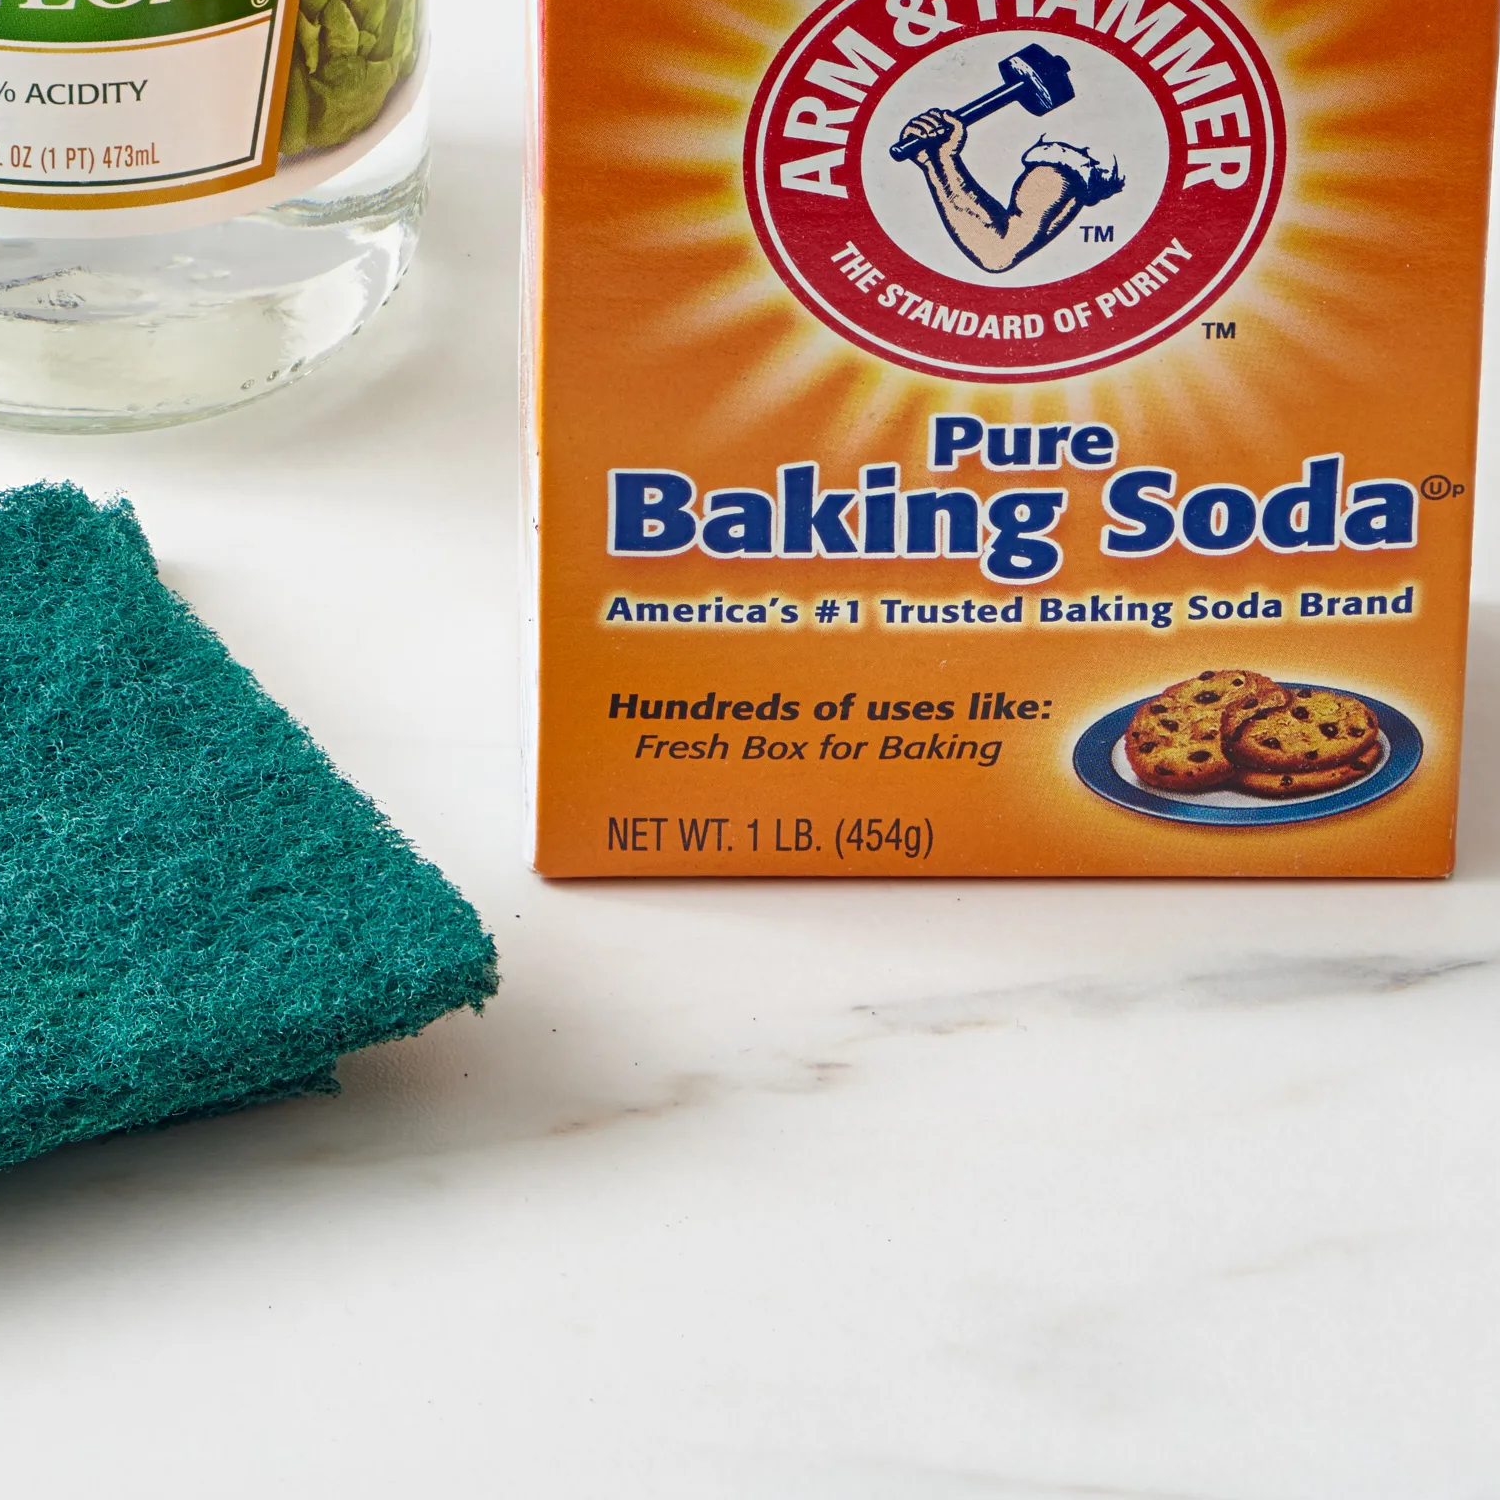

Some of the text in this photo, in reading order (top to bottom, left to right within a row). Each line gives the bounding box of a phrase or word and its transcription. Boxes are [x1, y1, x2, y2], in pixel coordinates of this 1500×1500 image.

[25, 79, 149, 106] ACIDITY
[780, 26, 895, 199] ARM
[10, 144, 33, 168] OZ
[40, 144, 59, 172] (1
[64, 143, 95, 171] PT)
[102, 141, 160, 169] 473mL
[1080, 225, 1115, 243] TM
[830, 239, 1193, 340] THE STANDARD OF PURITY
[1202, 322, 1237, 340] TM
[934, 418, 1113, 466] Pure
[612, 458, 1415, 581] Baking Soda
[607, 587, 1414, 629] America's #1 Trusted Baking Soda Brand
[608, 692, 1053, 722] Hundreds of uses like:
[635, 734, 1002, 767] Fresh Box for Baking
[607, 816, 935, 860] NET WT. 1 LB. (454g)
